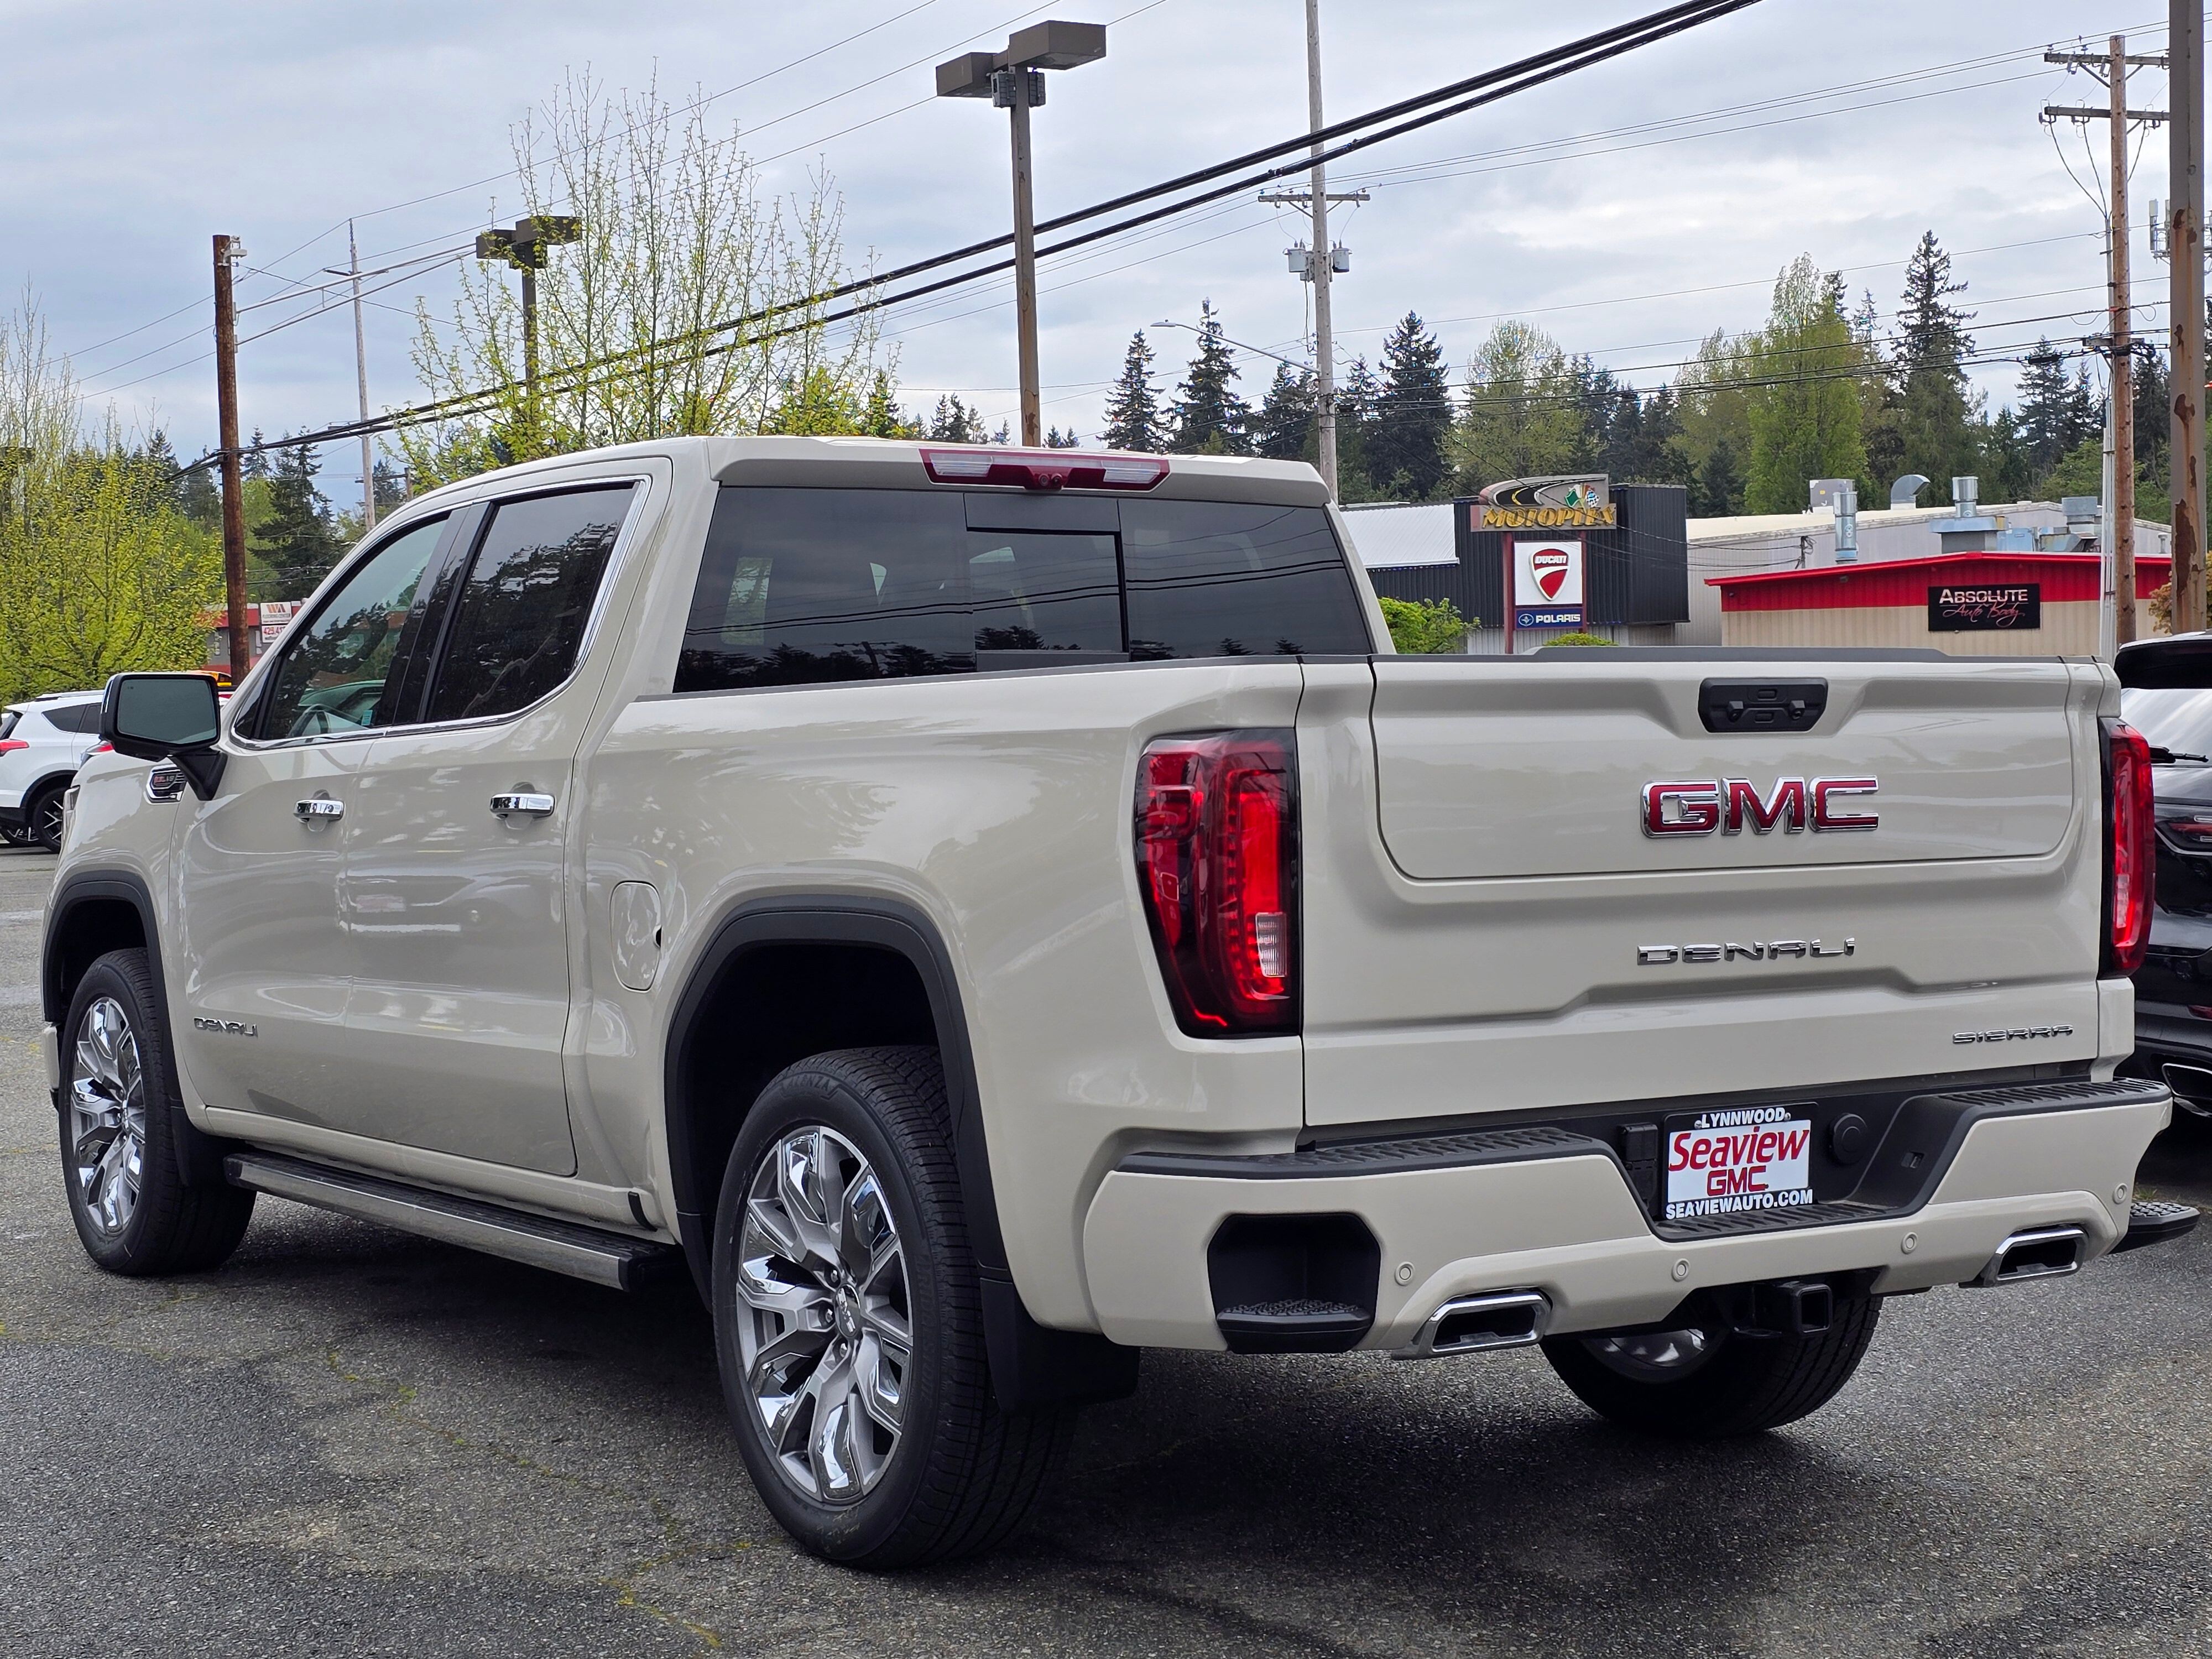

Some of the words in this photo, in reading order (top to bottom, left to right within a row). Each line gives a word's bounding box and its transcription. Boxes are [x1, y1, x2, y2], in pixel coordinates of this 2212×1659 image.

[1535, 555, 1567, 564] DUCATI
[1939, 588, 2028, 603] ABSOLUTE
[1536, 614, 1580, 623] POLARIS
[1943, 604, 1986, 622] Auto
[1987, 598, 2025, 627] Body
[1641, 775, 1879, 838] GMC
[1637, 936, 1855, 966] DENALI
[194, 1016, 258, 1037] DENALI
[1952, 1023, 2074, 1044] SIERRA
[1702, 1107, 1786, 1129] LYNNWOOD
[1668, 1126, 1810, 1172] Seaview
[1707, 1165, 1769, 1197] GMC
[1666, 1189, 1813, 1220] SEAVIEWAUTO.COM
